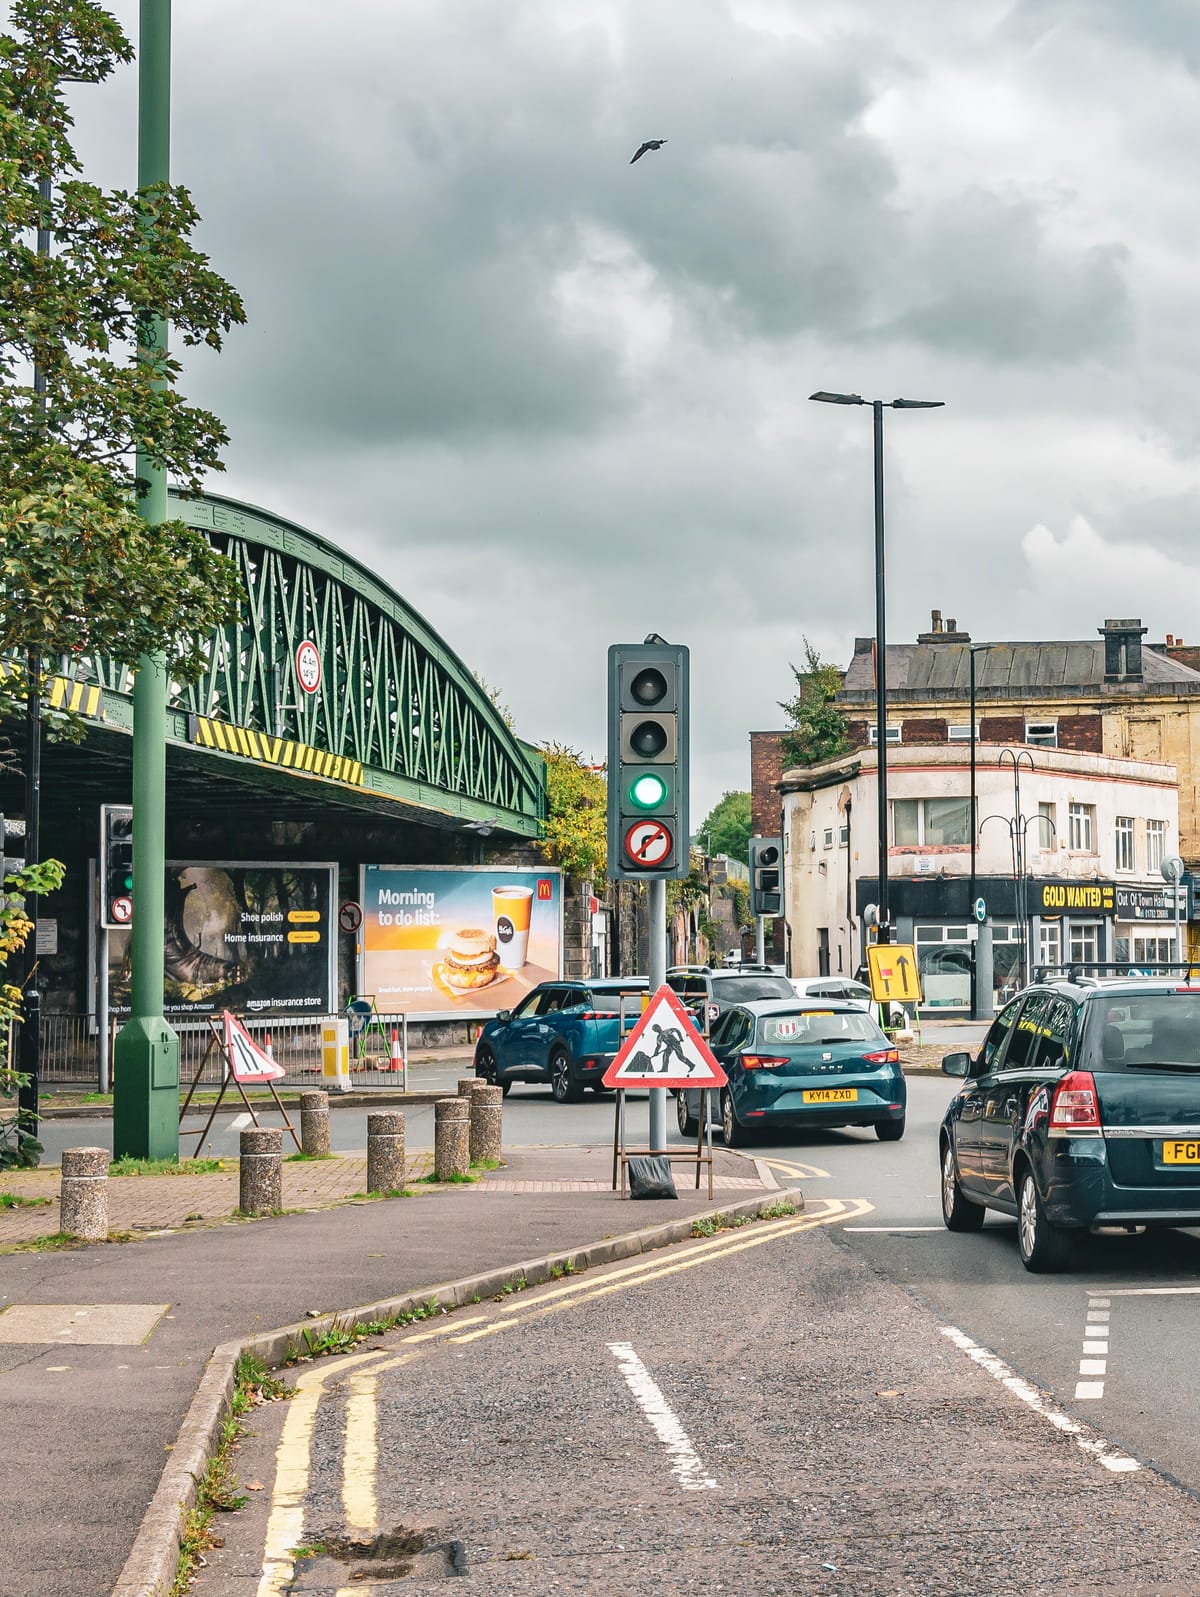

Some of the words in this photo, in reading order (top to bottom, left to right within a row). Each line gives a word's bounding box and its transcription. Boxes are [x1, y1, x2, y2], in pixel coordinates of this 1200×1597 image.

[1043, 886, 1065, 907] GOLD
[1066, 886, 1101, 908] WANTED
[1102, 888, 1114, 896] CASH
[378, 888, 434, 909] Morning
[1118, 892, 1128, 906] Out
[1130, 892, 1137, 906] Of
[1138, 893, 1153, 907] Town
[240, 912, 260, 922] Shoe
[260, 912, 284, 924] polish
[378, 910, 392, 926] to
[395, 909, 412, 926] do
[415, 909, 440, 926] list:
[224, 934, 247, 942] Home
[248, 933, 284, 942] insurance
[271, 998, 303, 1006] insurance
[304, 997, 322, 1005] store
[809, 1091, 830, 1100] KY14
[833, 1090, 851, 1099] ZXD
